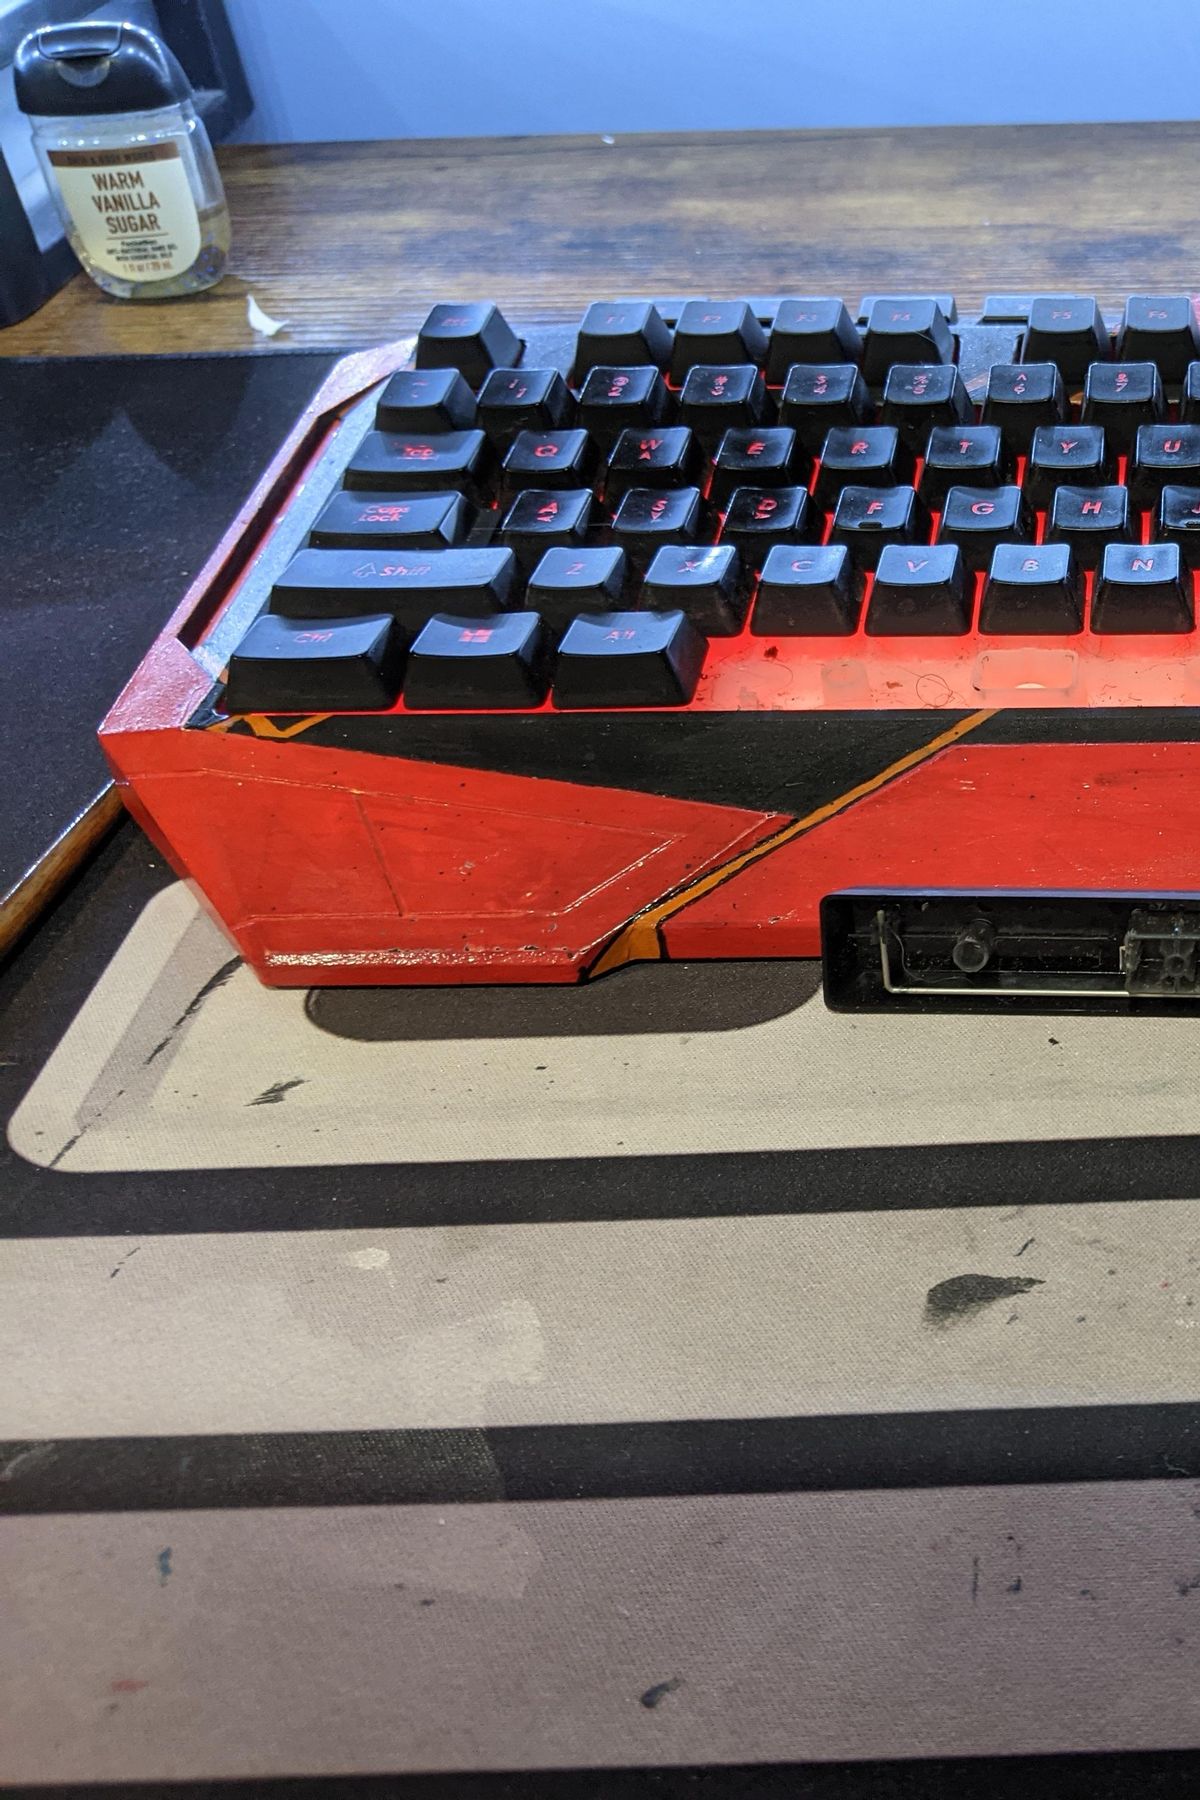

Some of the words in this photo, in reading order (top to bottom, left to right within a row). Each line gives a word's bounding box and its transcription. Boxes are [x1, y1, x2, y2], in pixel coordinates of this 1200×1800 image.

[92, 171, 144, 191] WARM
[92, 191, 161, 212] VANILLA
[106, 214, 161, 234] SUGAR
[703, 315, 722, 323] F2
[607, 386, 622, 397] 2
[711, 385, 724, 396] 3
[813, 385, 827, 394] 4
[912, 384, 928, 394] 5
[1014, 383, 1025, 394] 6
[1115, 382, 1128, 392] 7
[639, 439, 664, 450] W
[747, 440, 766, 455] E
[851, 440, 870, 454] R
[960, 440, 973, 454] T
[1060, 440, 1080, 453] Y
[1163, 440, 1183, 453] U
[534, 444, 559, 459] Q
[364, 505, 411, 515] Caps
[537, 501, 558, 514] A
[652, 498, 668, 511] S
[757, 498, 778, 511] D
[866, 502, 883, 515] F
[971, 502, 995, 515] G
[1081, 501, 1101, 514] H
[359, 513, 402, 522] Lock
[379, 564, 432, 577] Shift
[566, 562, 586, 575] Z
[677, 561, 700, 573] X
[791, 560, 815, 572] C
[907, 560, 928, 572] V
[1021, 559, 1039, 571] B
[1132, 559, 1154, 571] N
[294, 632, 333, 643] Ctrl
[603, 630, 636, 640] Alt
